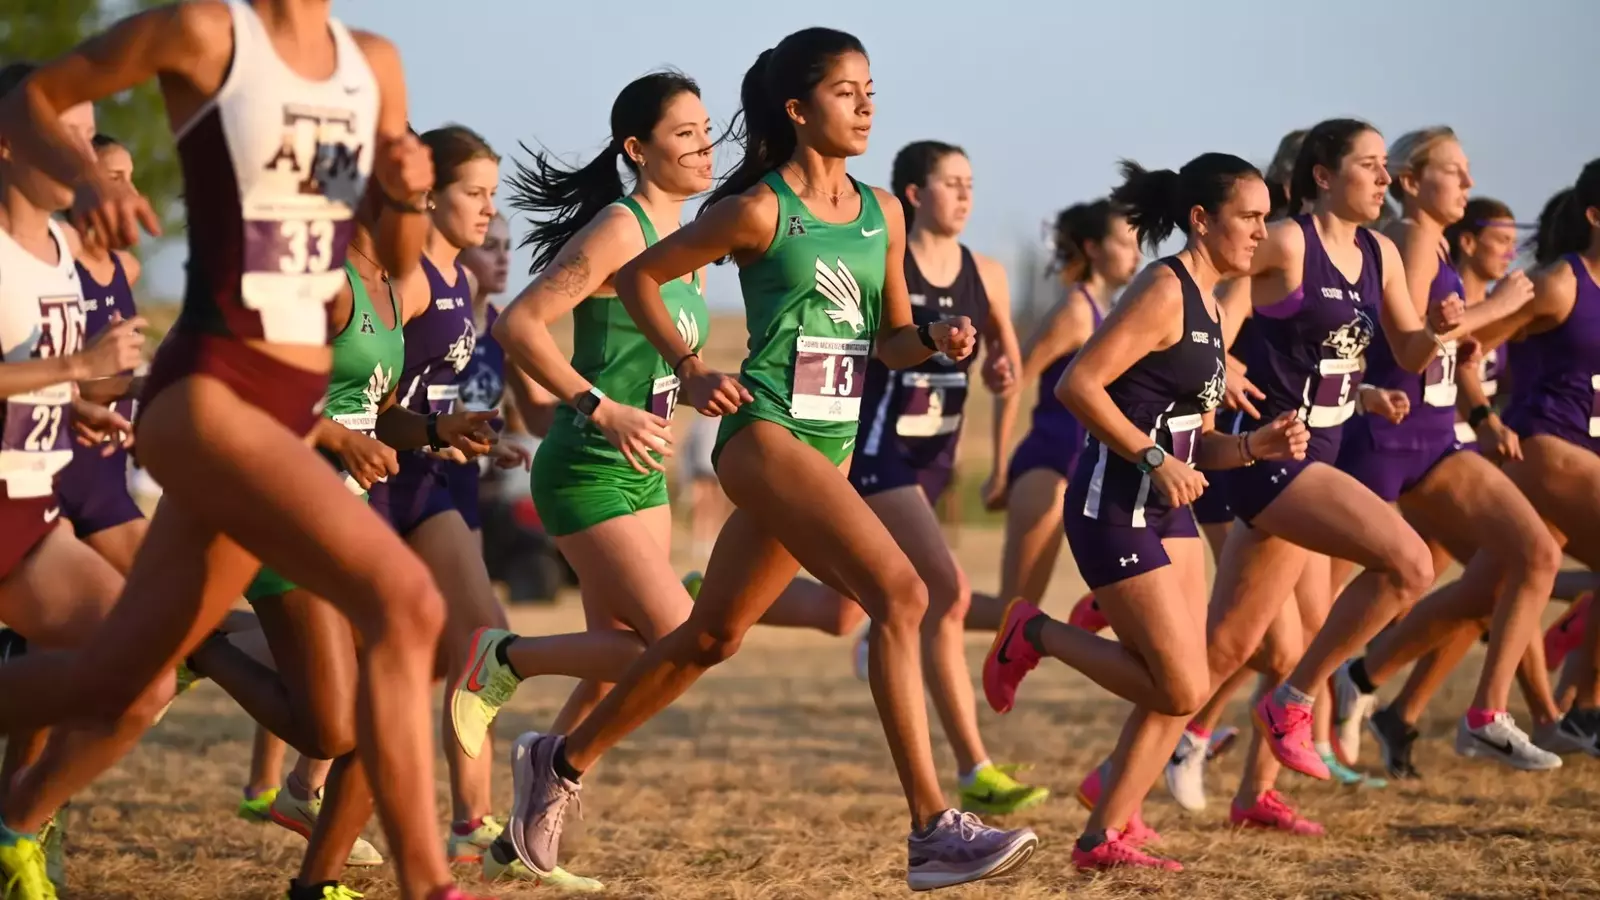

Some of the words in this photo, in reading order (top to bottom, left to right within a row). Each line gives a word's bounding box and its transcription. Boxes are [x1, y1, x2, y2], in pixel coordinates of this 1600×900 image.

[279, 219, 334, 274] 33
[820, 355, 854, 396] 13
[24, 405, 63, 451] 23
